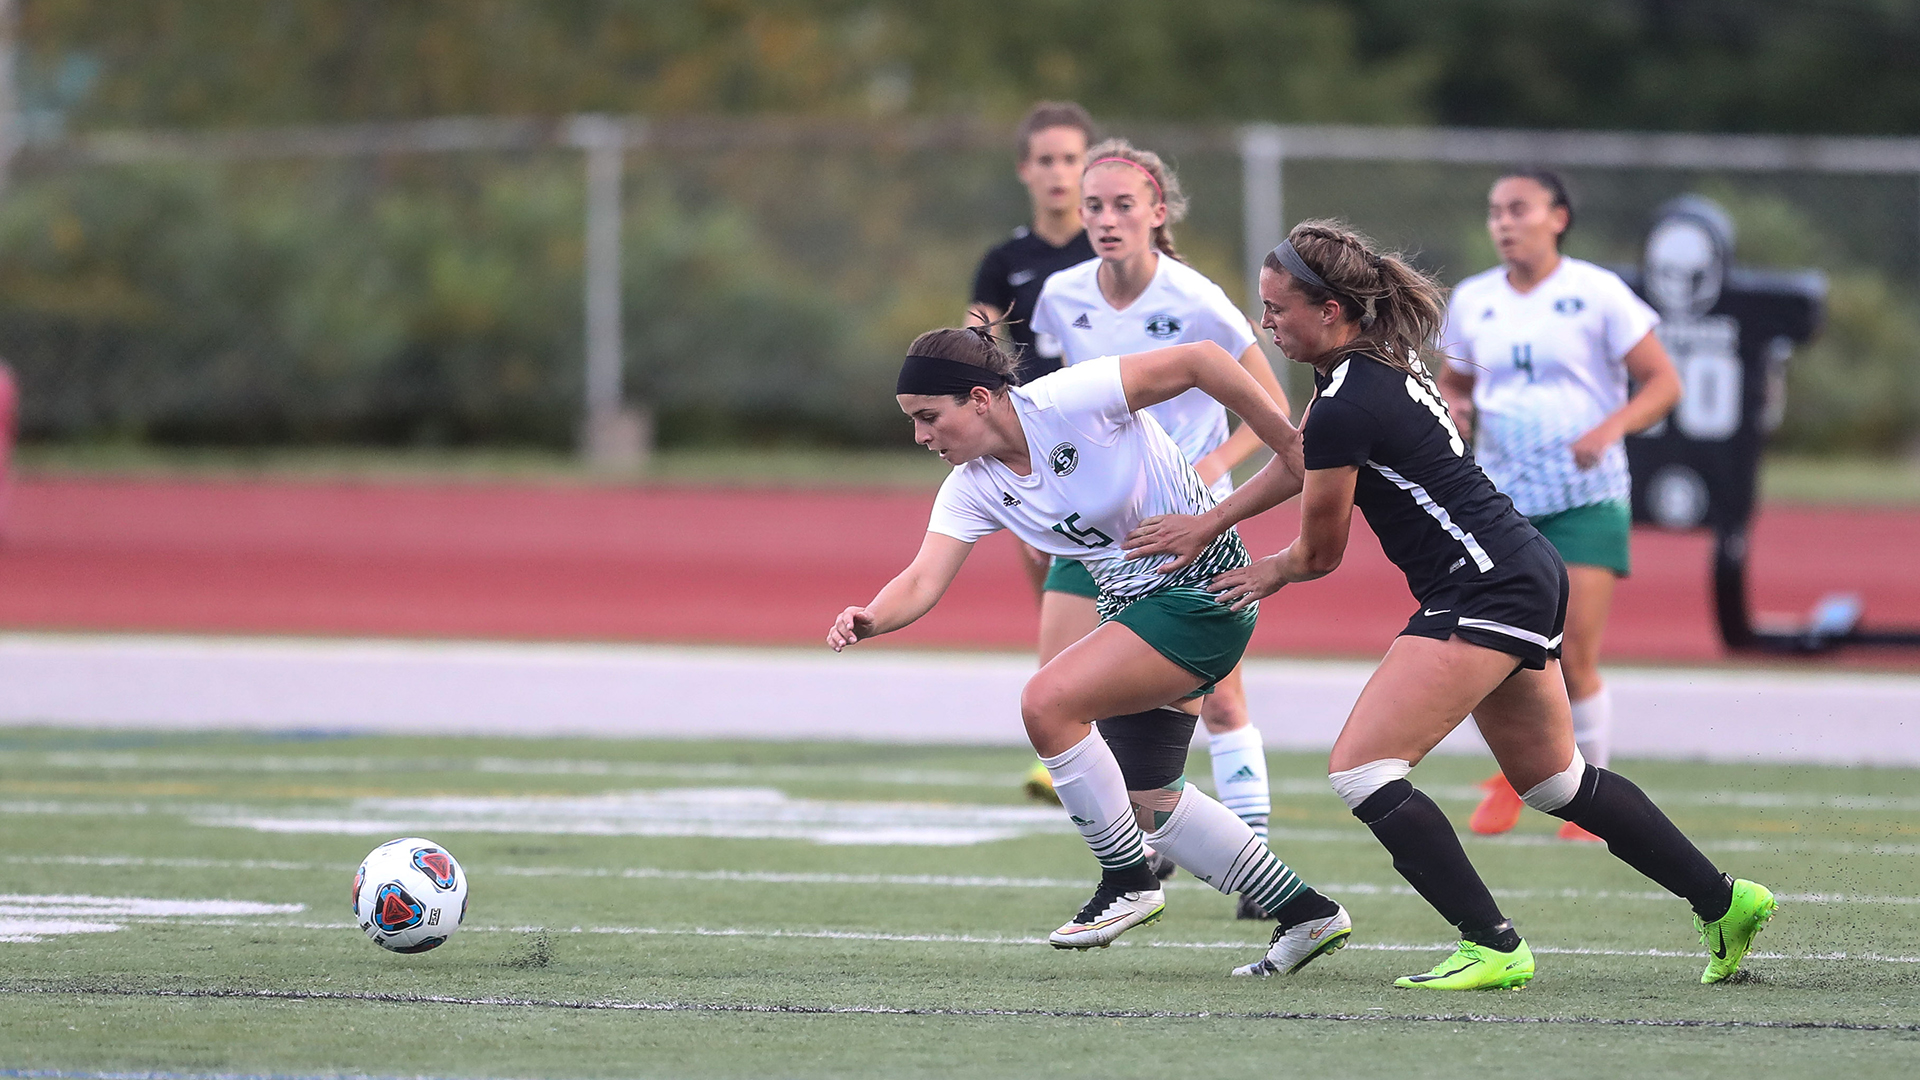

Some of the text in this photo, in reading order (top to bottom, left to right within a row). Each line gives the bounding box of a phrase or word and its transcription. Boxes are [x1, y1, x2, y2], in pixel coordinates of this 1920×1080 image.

[1156, 321, 1171, 336] S
[1512, 343, 1535, 385] 4
[1056, 451, 1072, 469] S
[1051, 511, 1115, 550] 15
[429, 908, 440, 926] PSAC
